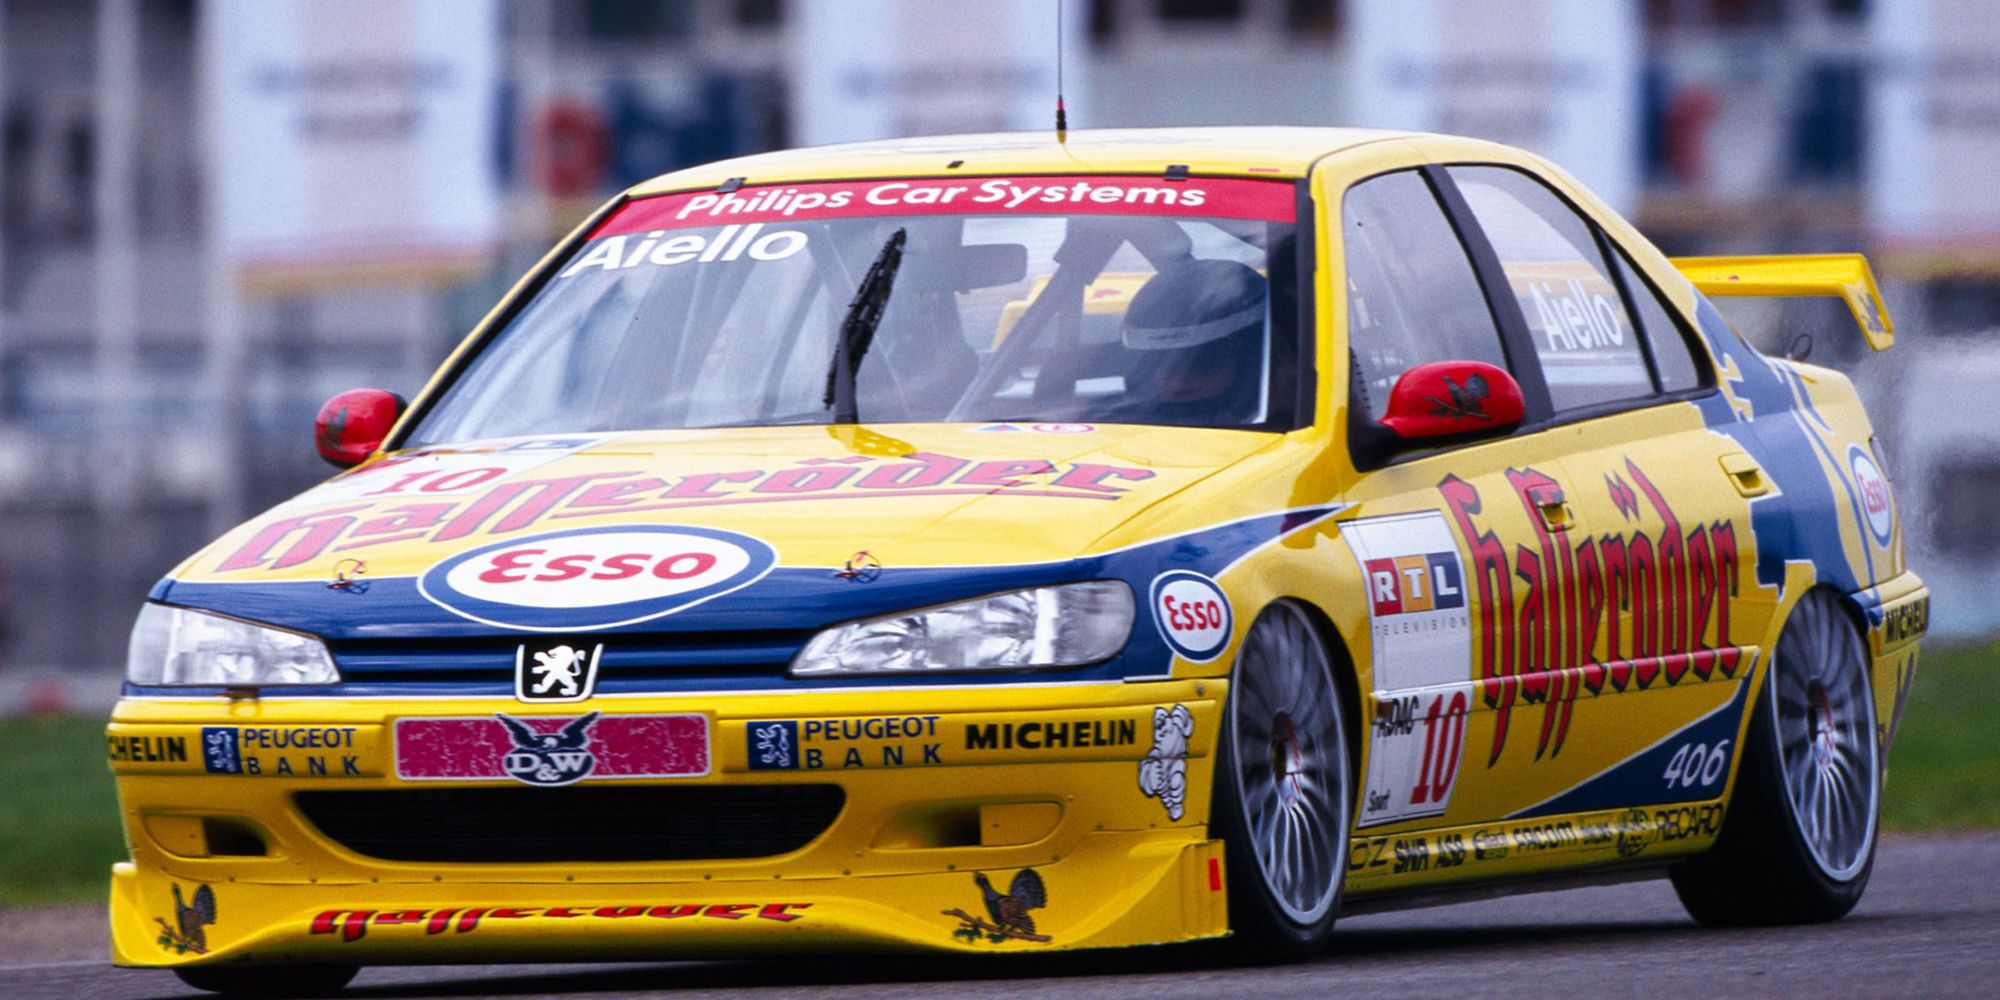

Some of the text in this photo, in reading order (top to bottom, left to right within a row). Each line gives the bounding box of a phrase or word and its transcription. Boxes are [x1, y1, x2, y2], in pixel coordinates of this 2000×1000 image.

[675, 180, 1206, 220] Philips Car Systems
[560, 223, 809, 278] Aiello
[1528, 277, 1624, 351] Aiello
[358, 467, 508, 497] 10
[1371, 565, 1459, 604] RTL
[244, 728, 358, 749] PEUGEOT
[805, 715, 940, 742] PEUGEOT
[964, 718, 1136, 751] MICHELIN
[246, 755, 362, 776] BANK
[806, 744, 942, 769] BANK
[1408, 690, 1467, 805] 10
[1662, 738, 1730, 790] 406
[506, 752, 592, 781] D&W
[1656, 801, 1724, 843] RECARO
